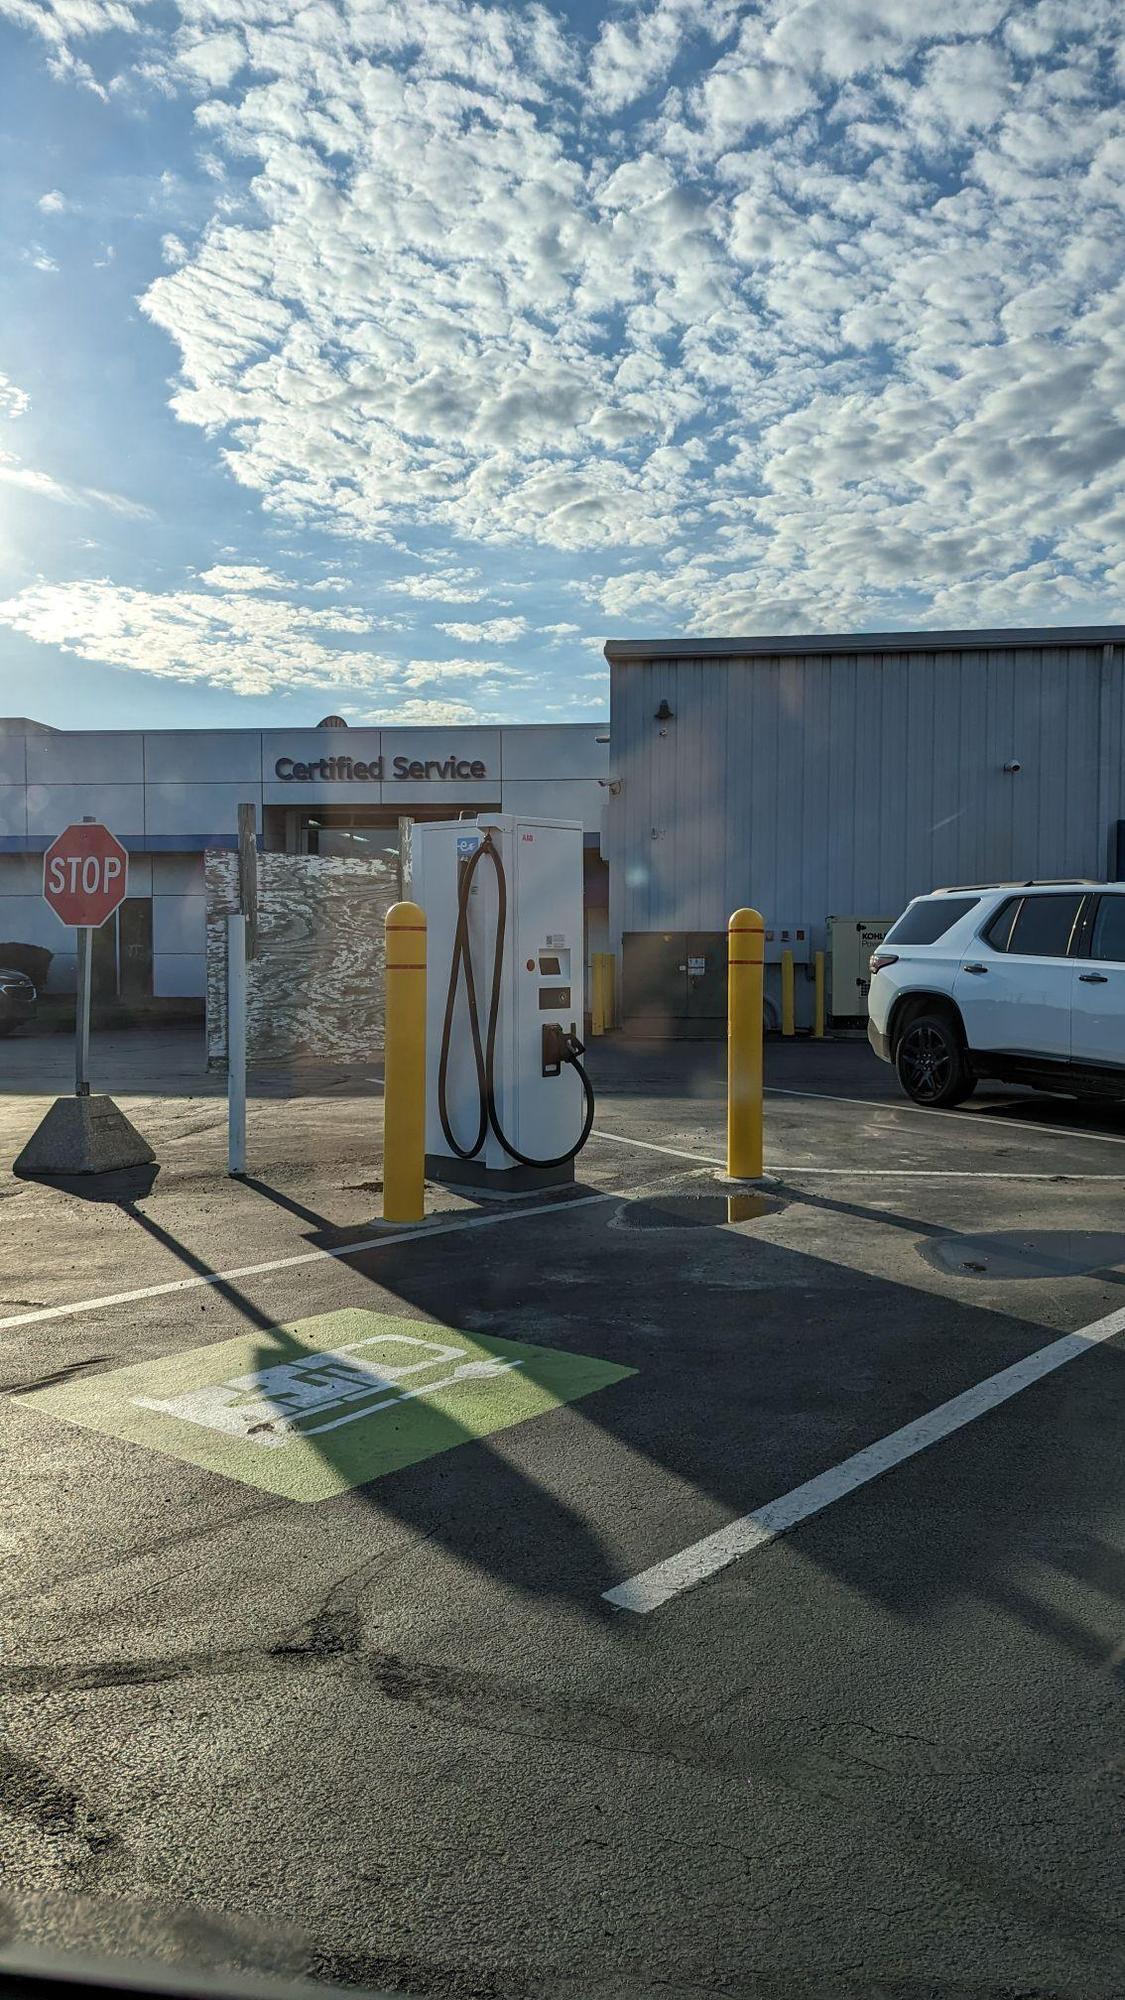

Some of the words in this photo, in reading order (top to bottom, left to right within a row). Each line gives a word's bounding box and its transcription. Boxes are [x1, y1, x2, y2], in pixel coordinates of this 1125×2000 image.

[275, 756, 384, 781] Certified
[392, 755, 486, 780] Service
[48, 856, 121, 894] STOP
